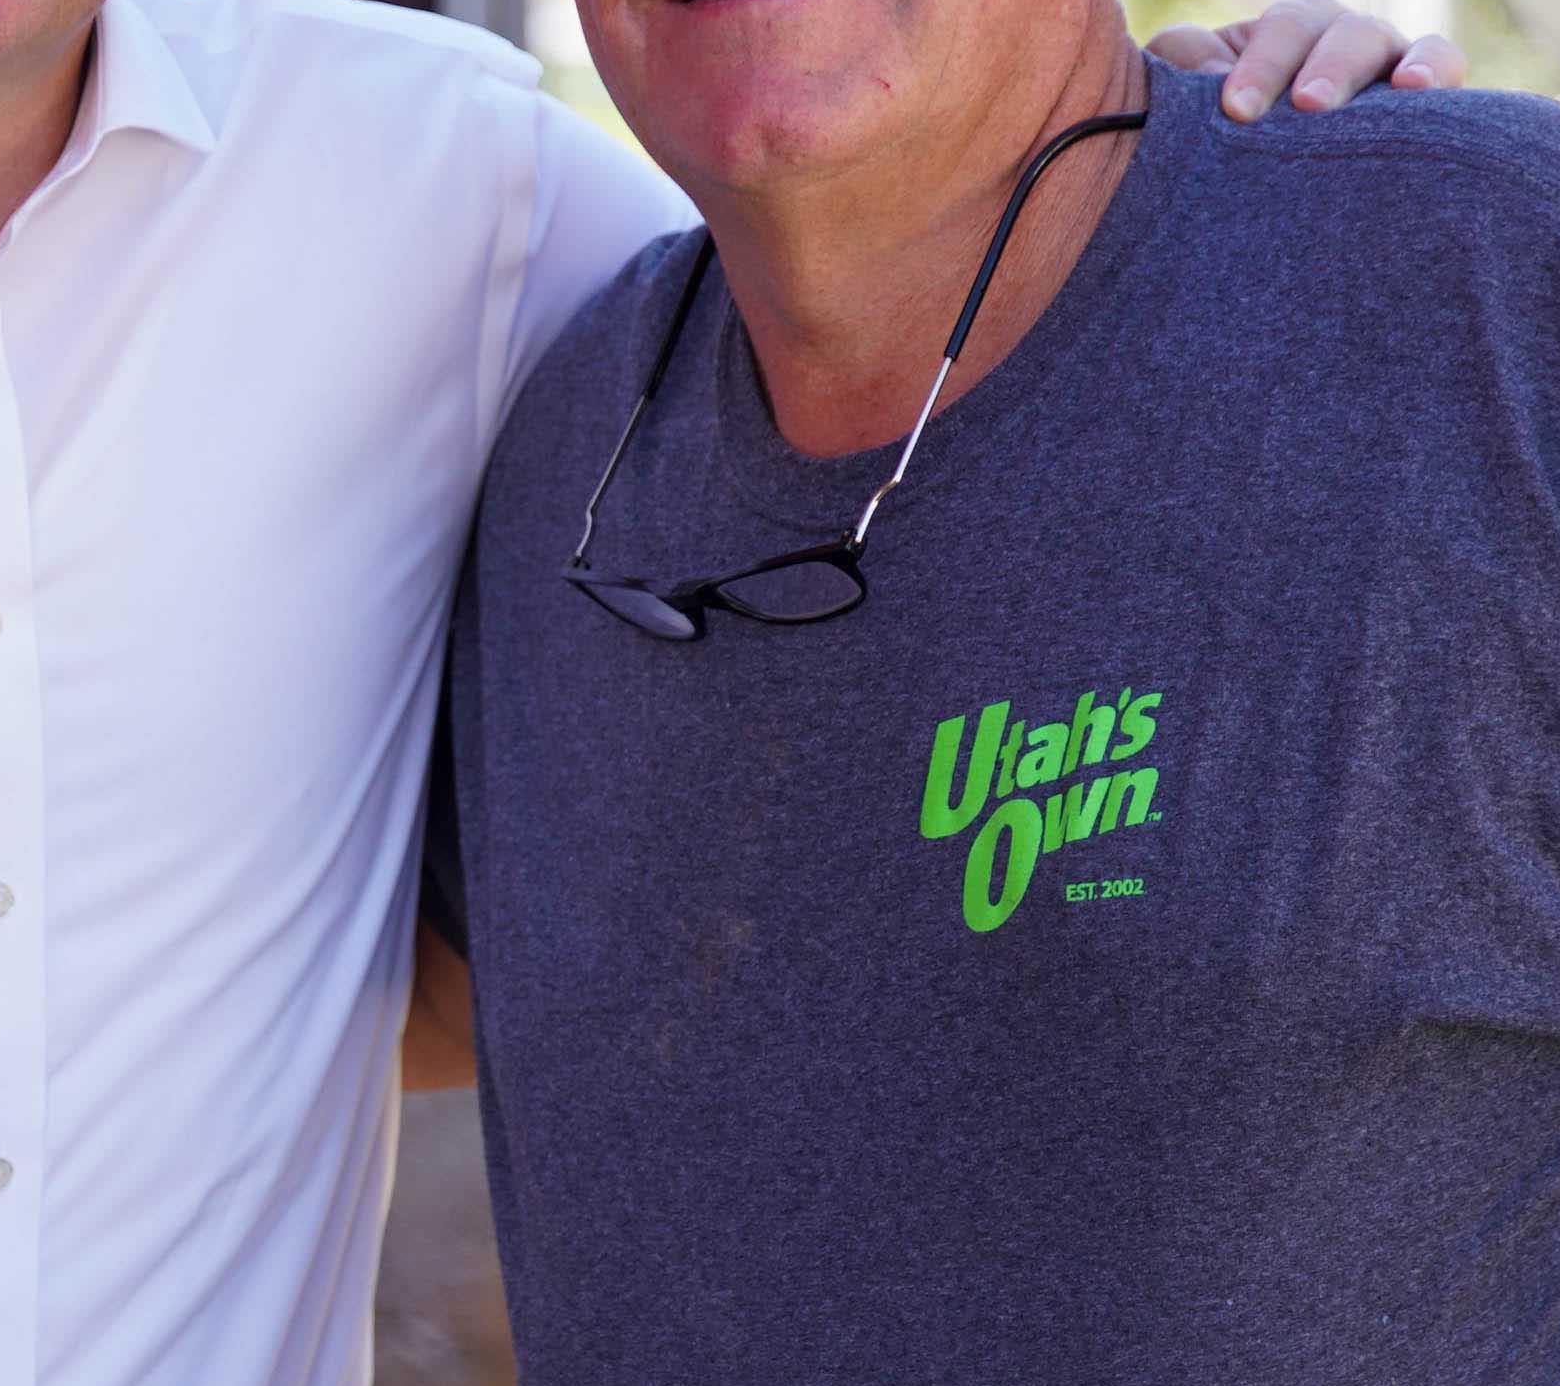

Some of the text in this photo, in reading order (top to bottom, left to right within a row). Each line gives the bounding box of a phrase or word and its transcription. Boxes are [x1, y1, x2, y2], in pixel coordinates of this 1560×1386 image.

[920, 686, 1163, 839] Utah's
[963, 767, 1159, 932] Own
[1066, 878, 1144, 901] EST. 2002
